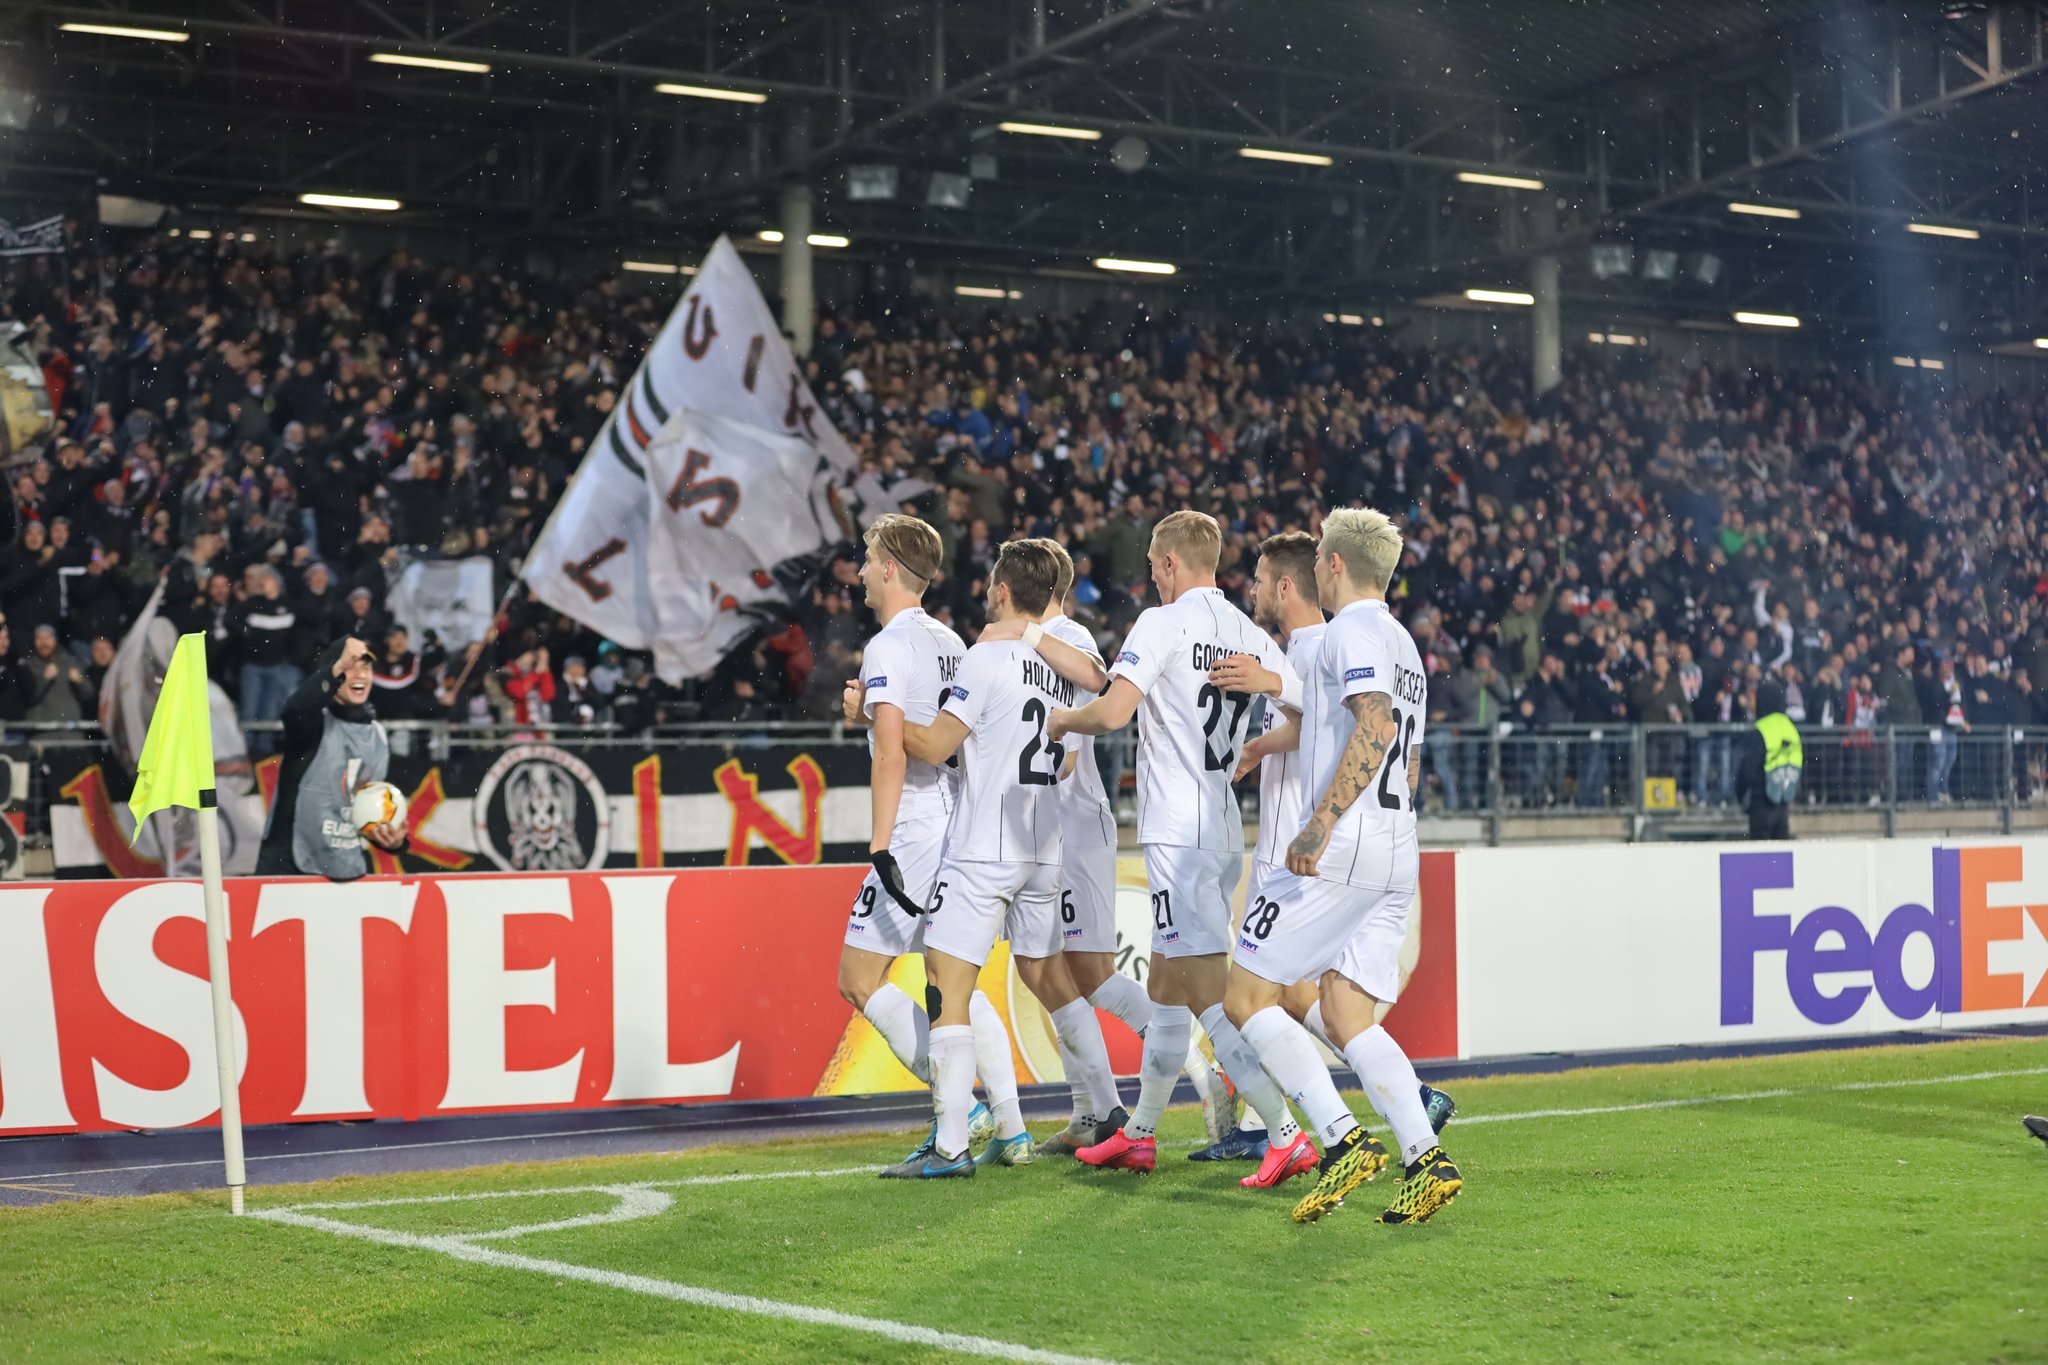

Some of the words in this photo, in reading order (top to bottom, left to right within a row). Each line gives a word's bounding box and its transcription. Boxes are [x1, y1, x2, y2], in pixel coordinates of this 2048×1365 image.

[1197, 682, 1252, 772] 27
[1152, 889, 1174, 930] 27
[1242, 895, 1280, 940] 28
